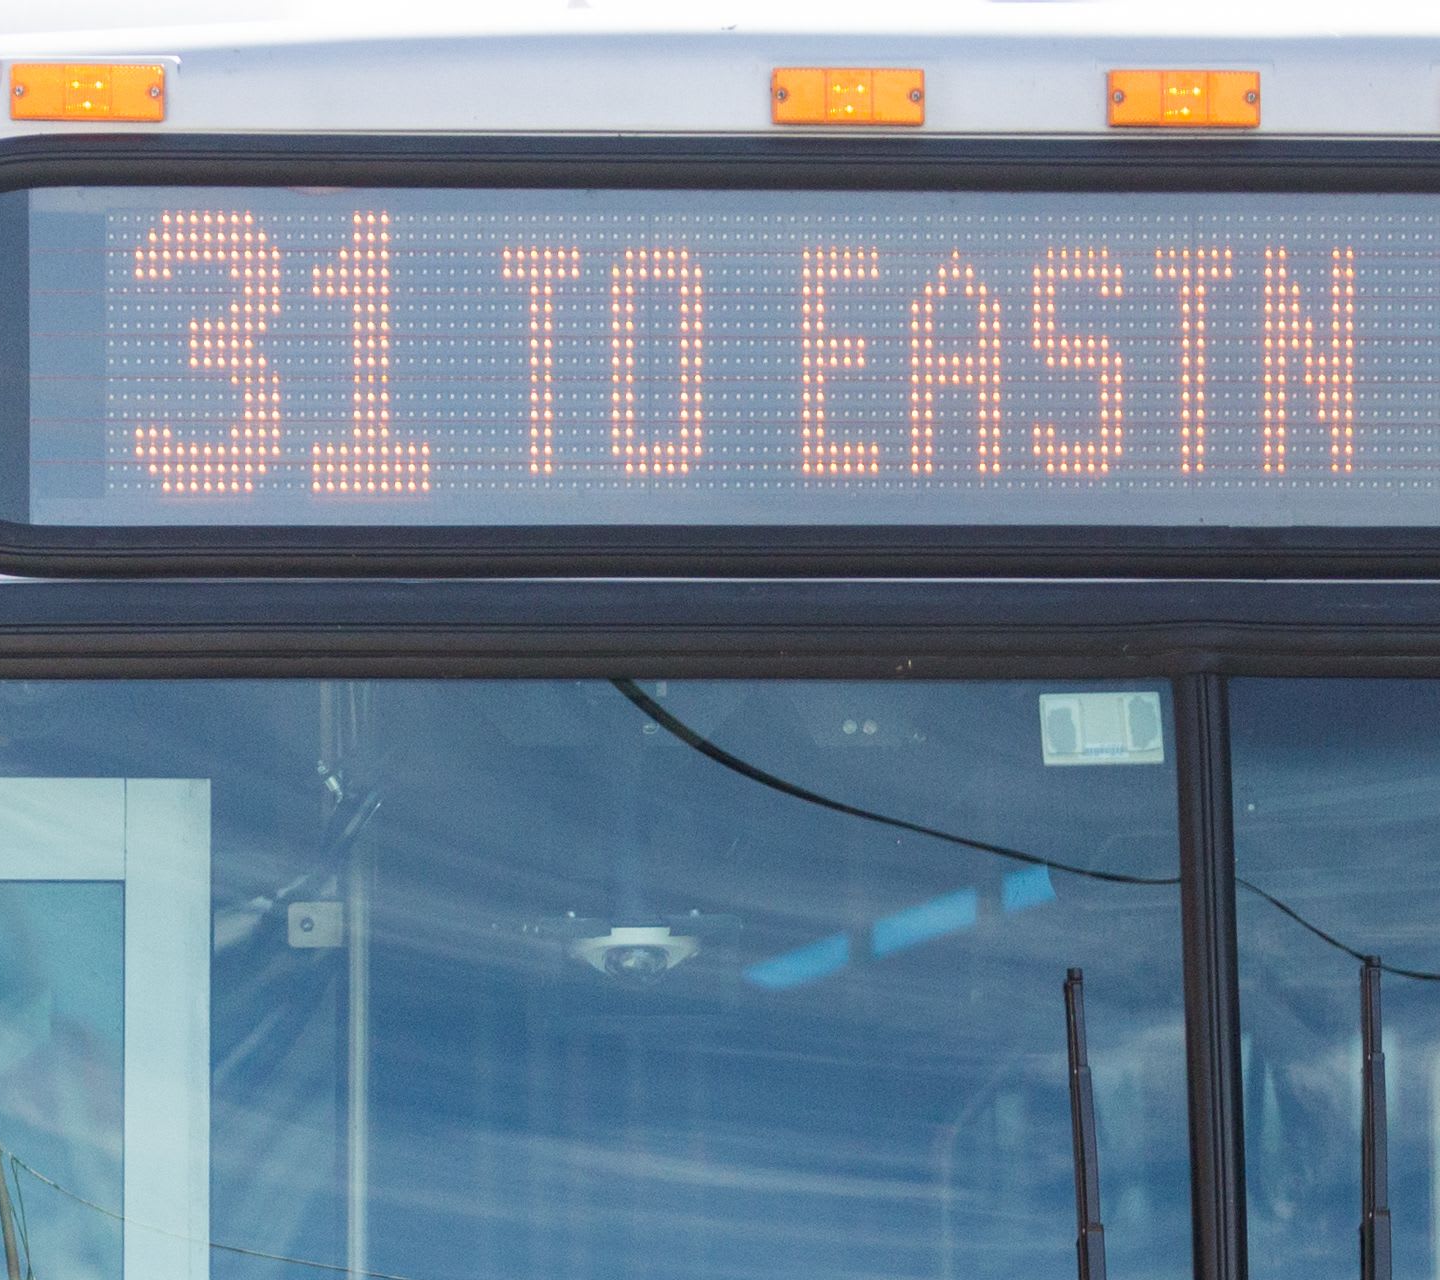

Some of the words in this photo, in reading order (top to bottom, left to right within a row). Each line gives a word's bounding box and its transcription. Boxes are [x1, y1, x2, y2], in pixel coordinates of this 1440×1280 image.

[129, 208, 433, 497] 31
[499, 244, 706, 480] TO
[798, 244, 1358, 480] EASTN
